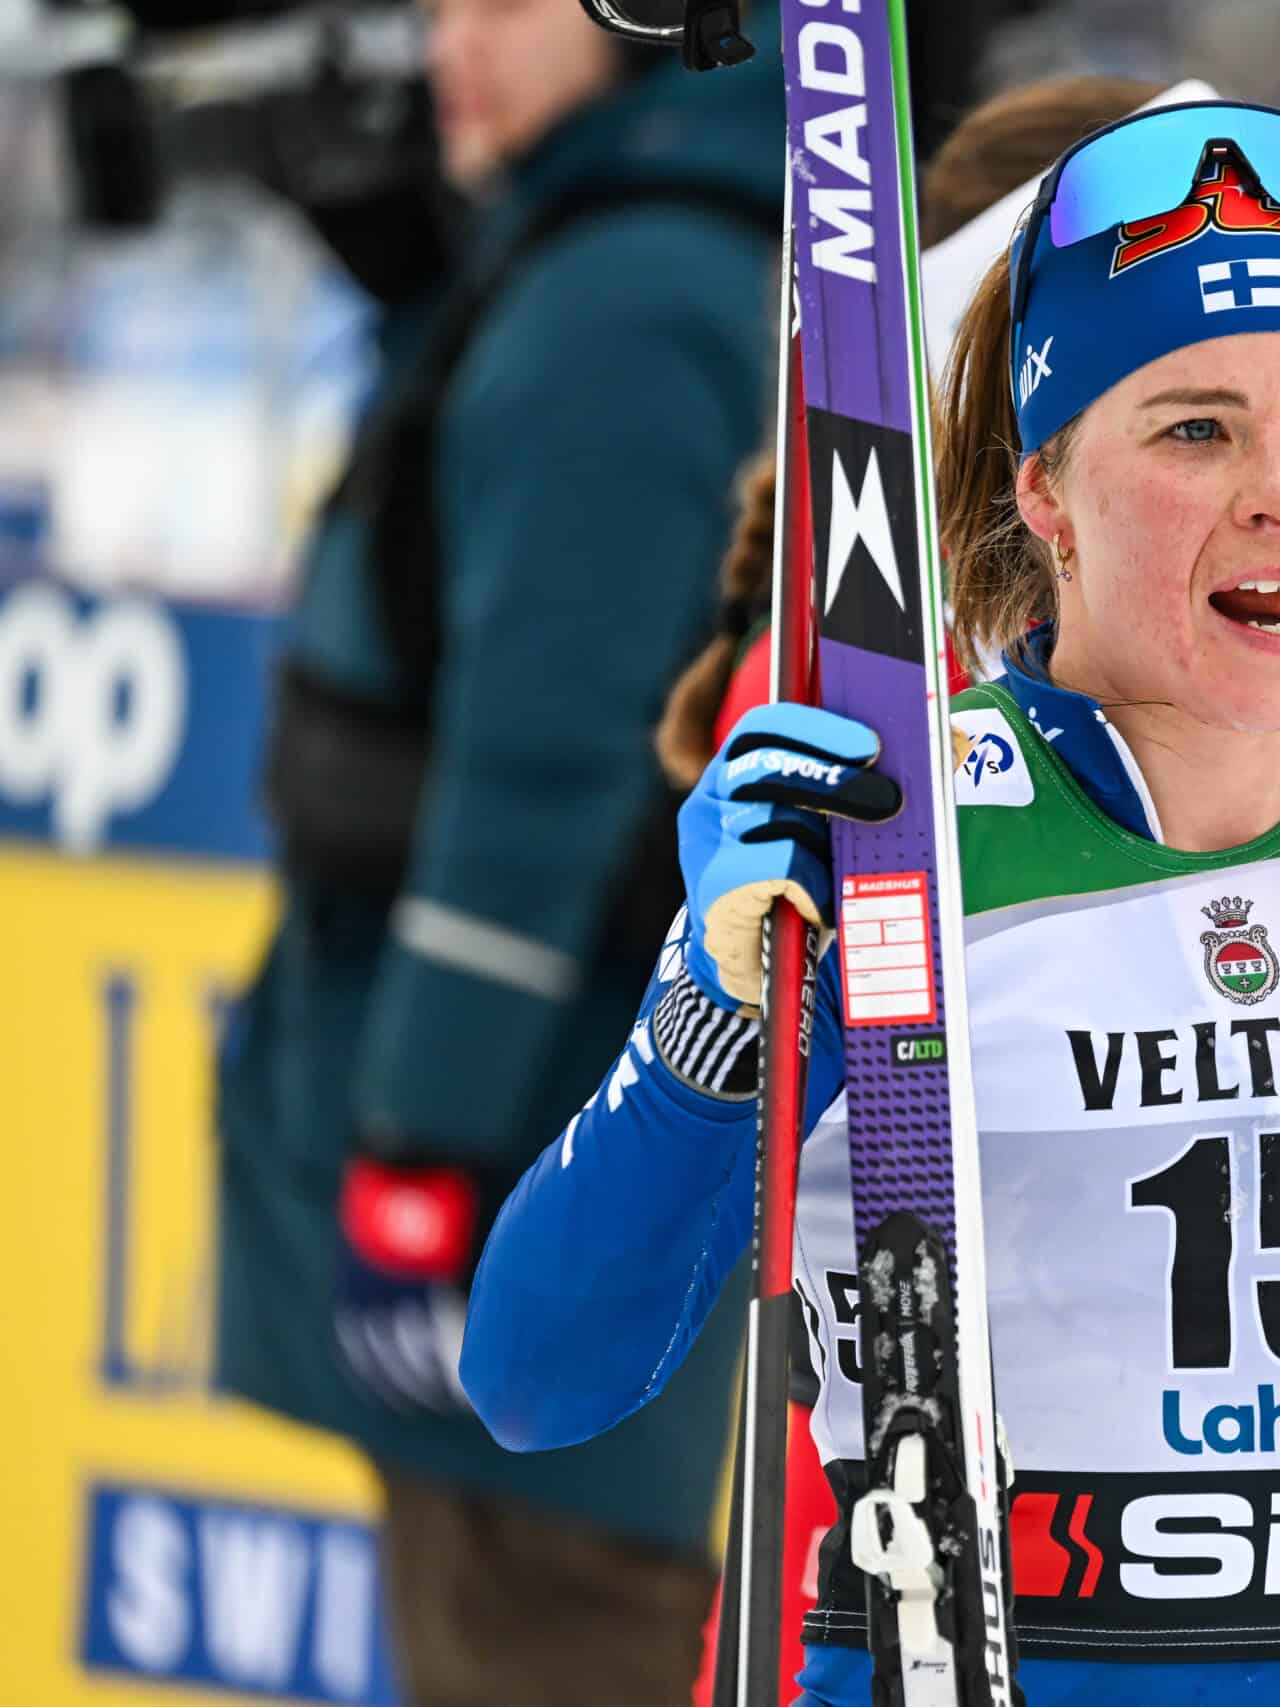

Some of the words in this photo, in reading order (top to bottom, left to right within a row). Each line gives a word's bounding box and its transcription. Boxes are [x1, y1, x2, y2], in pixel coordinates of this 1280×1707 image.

[798, 0, 877, 284] MAD
[858, 878, 921, 892] MADSHUS
[979, 1527, 1006, 1707] HUS
